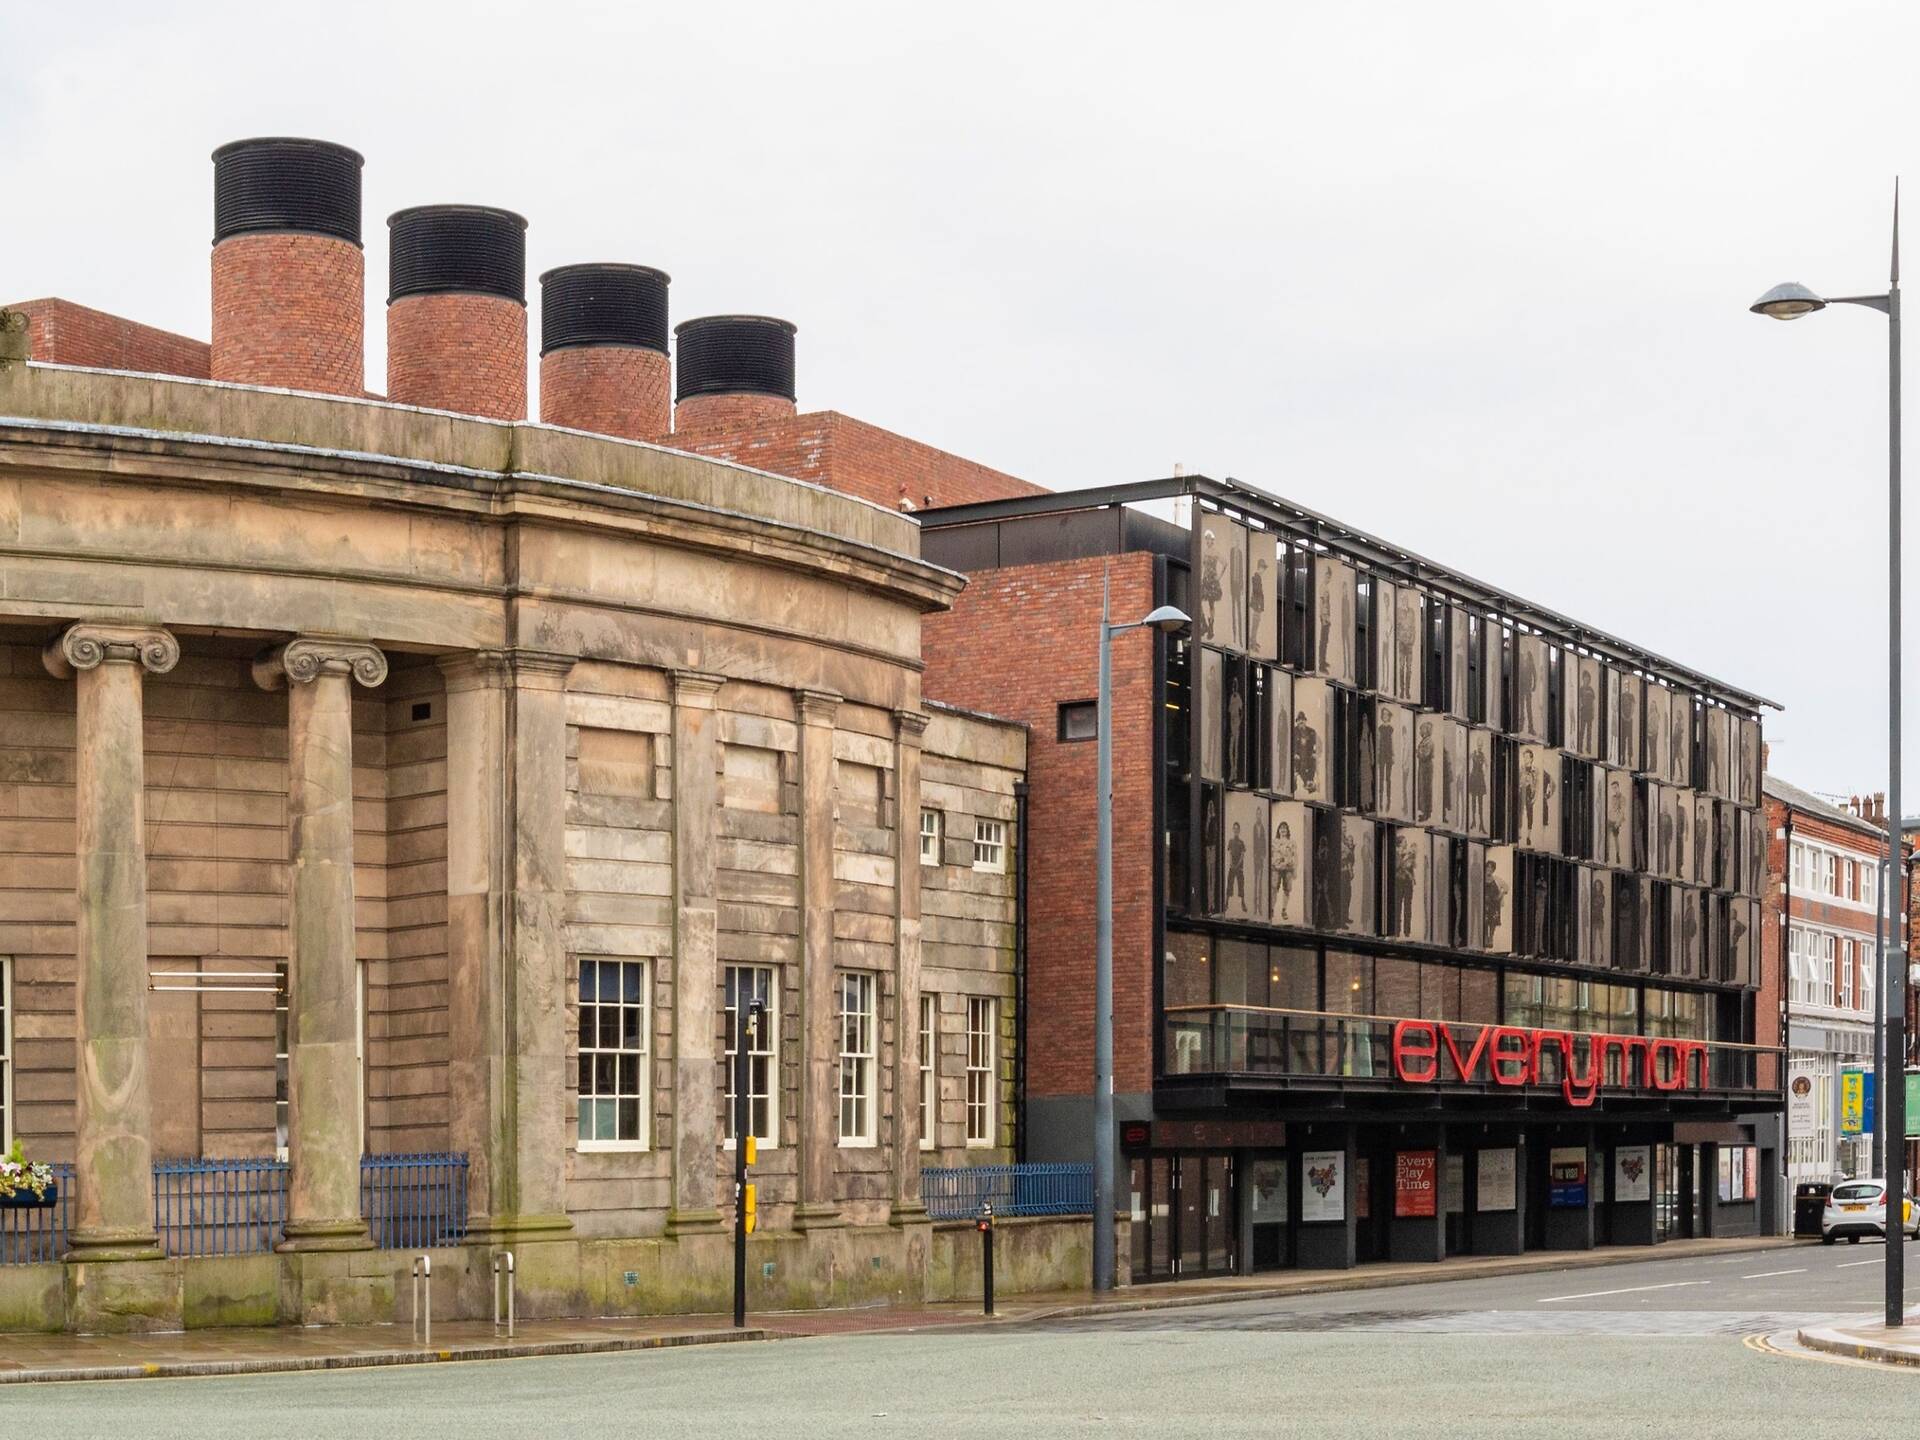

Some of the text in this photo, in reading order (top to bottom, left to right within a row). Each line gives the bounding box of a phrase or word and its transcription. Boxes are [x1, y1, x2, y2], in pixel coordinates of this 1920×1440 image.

[1393, 1020, 1709, 1107] everyman
[1397, 1155, 1434, 1168] Every
[1397, 1167, 1424, 1180] Play
[1396, 1178, 1430, 1190] Time
